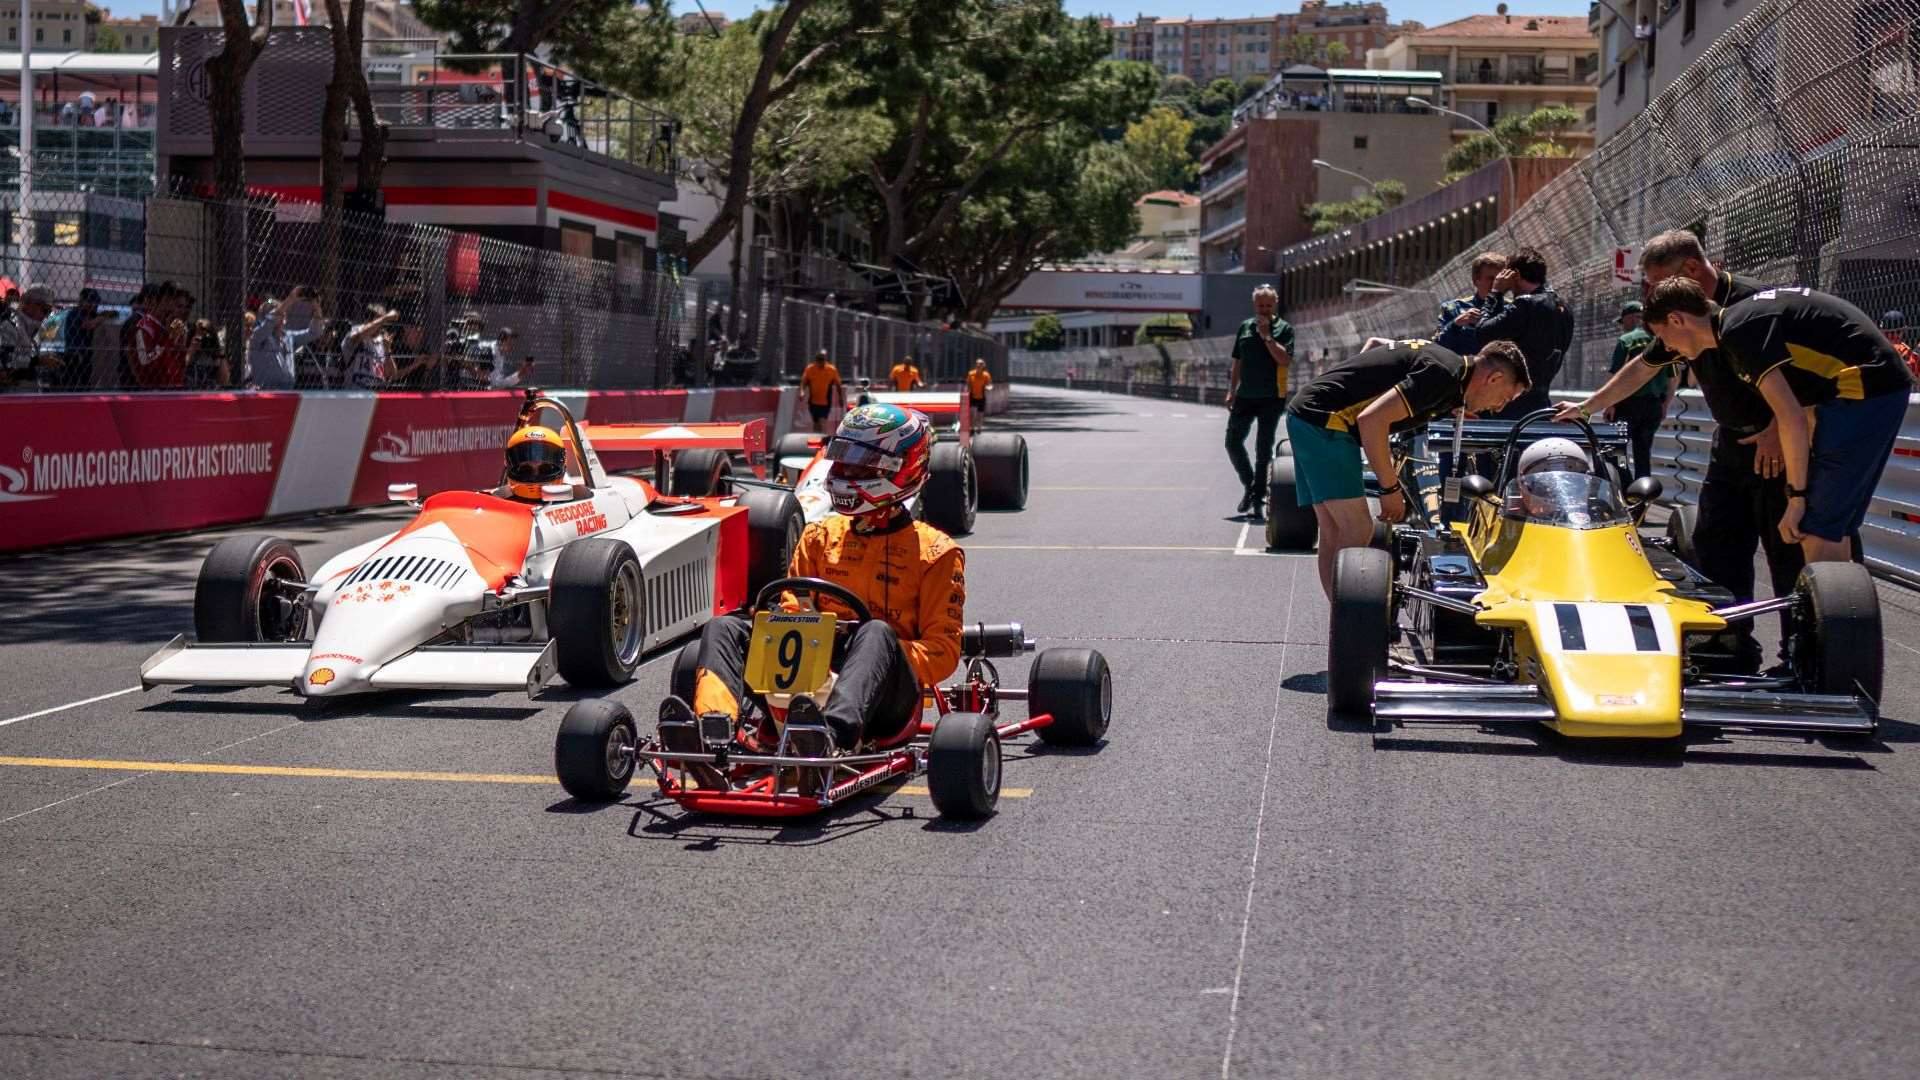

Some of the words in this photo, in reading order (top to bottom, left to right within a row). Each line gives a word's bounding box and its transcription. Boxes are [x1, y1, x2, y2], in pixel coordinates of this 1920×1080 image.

[544, 501, 595, 526] THEODORE
[575, 513, 607, 536] RACING
[1553, 603, 1661, 651] 11
[775, 629, 803, 690] 9
